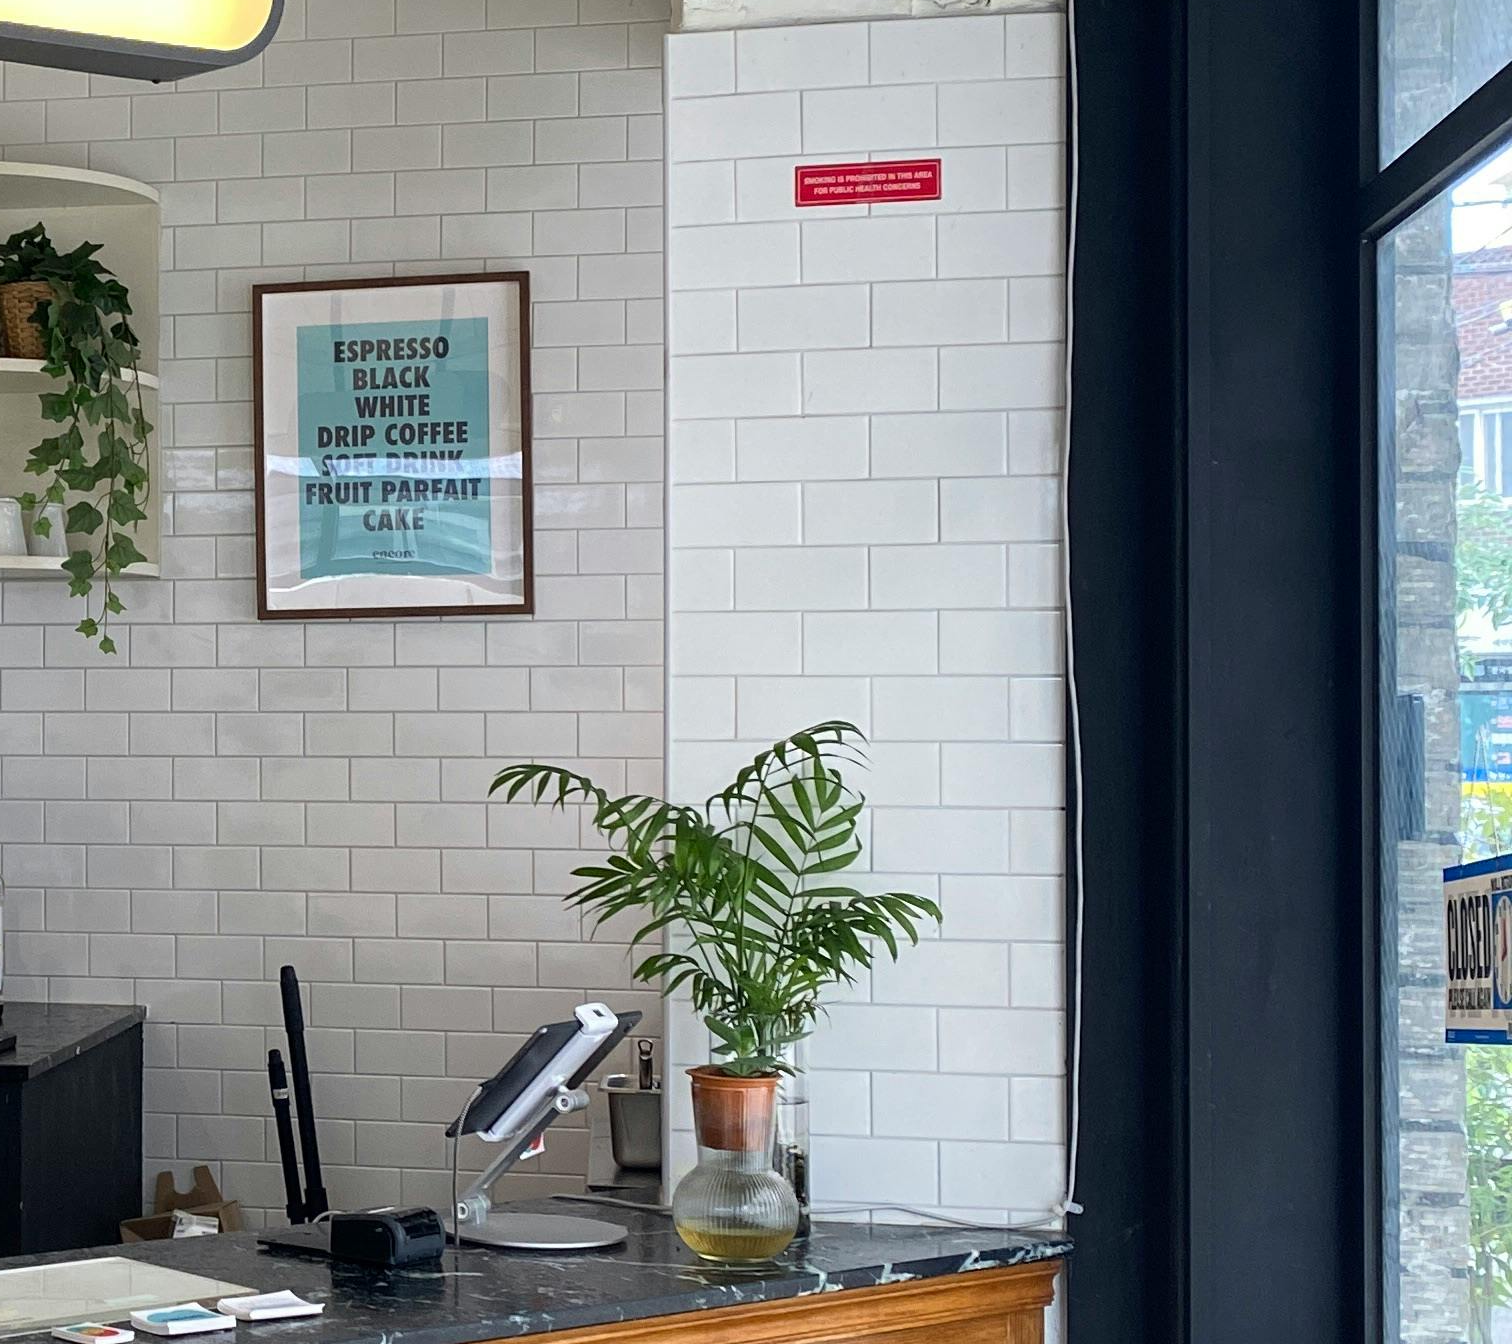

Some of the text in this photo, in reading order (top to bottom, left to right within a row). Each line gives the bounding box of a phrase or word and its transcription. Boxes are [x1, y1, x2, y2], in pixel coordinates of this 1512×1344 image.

[804, 176, 836, 185] SMOKING
[846, 173, 886, 182] PROHIBITED
[897, 172, 912, 180] THIS
[914, 171, 933, 179] AREA
[814, 182, 921, 195] FOR PUBLIC HEALTH CONCERNS
[334, 336, 449, 363] ESPRESSO
[353, 366, 430, 390] BLACK
[355, 394, 430, 418] WHITE
[317, 421, 468, 448] DRIP COFFEE
[322, 450, 464, 476] SOFT DRINK
[305, 478, 481, 505] FRUIT PARFAIT
[363, 507, 425, 532] CAKE
[372, 549, 416, 560] encore
[1447, 894, 1492, 981] CLOSED
